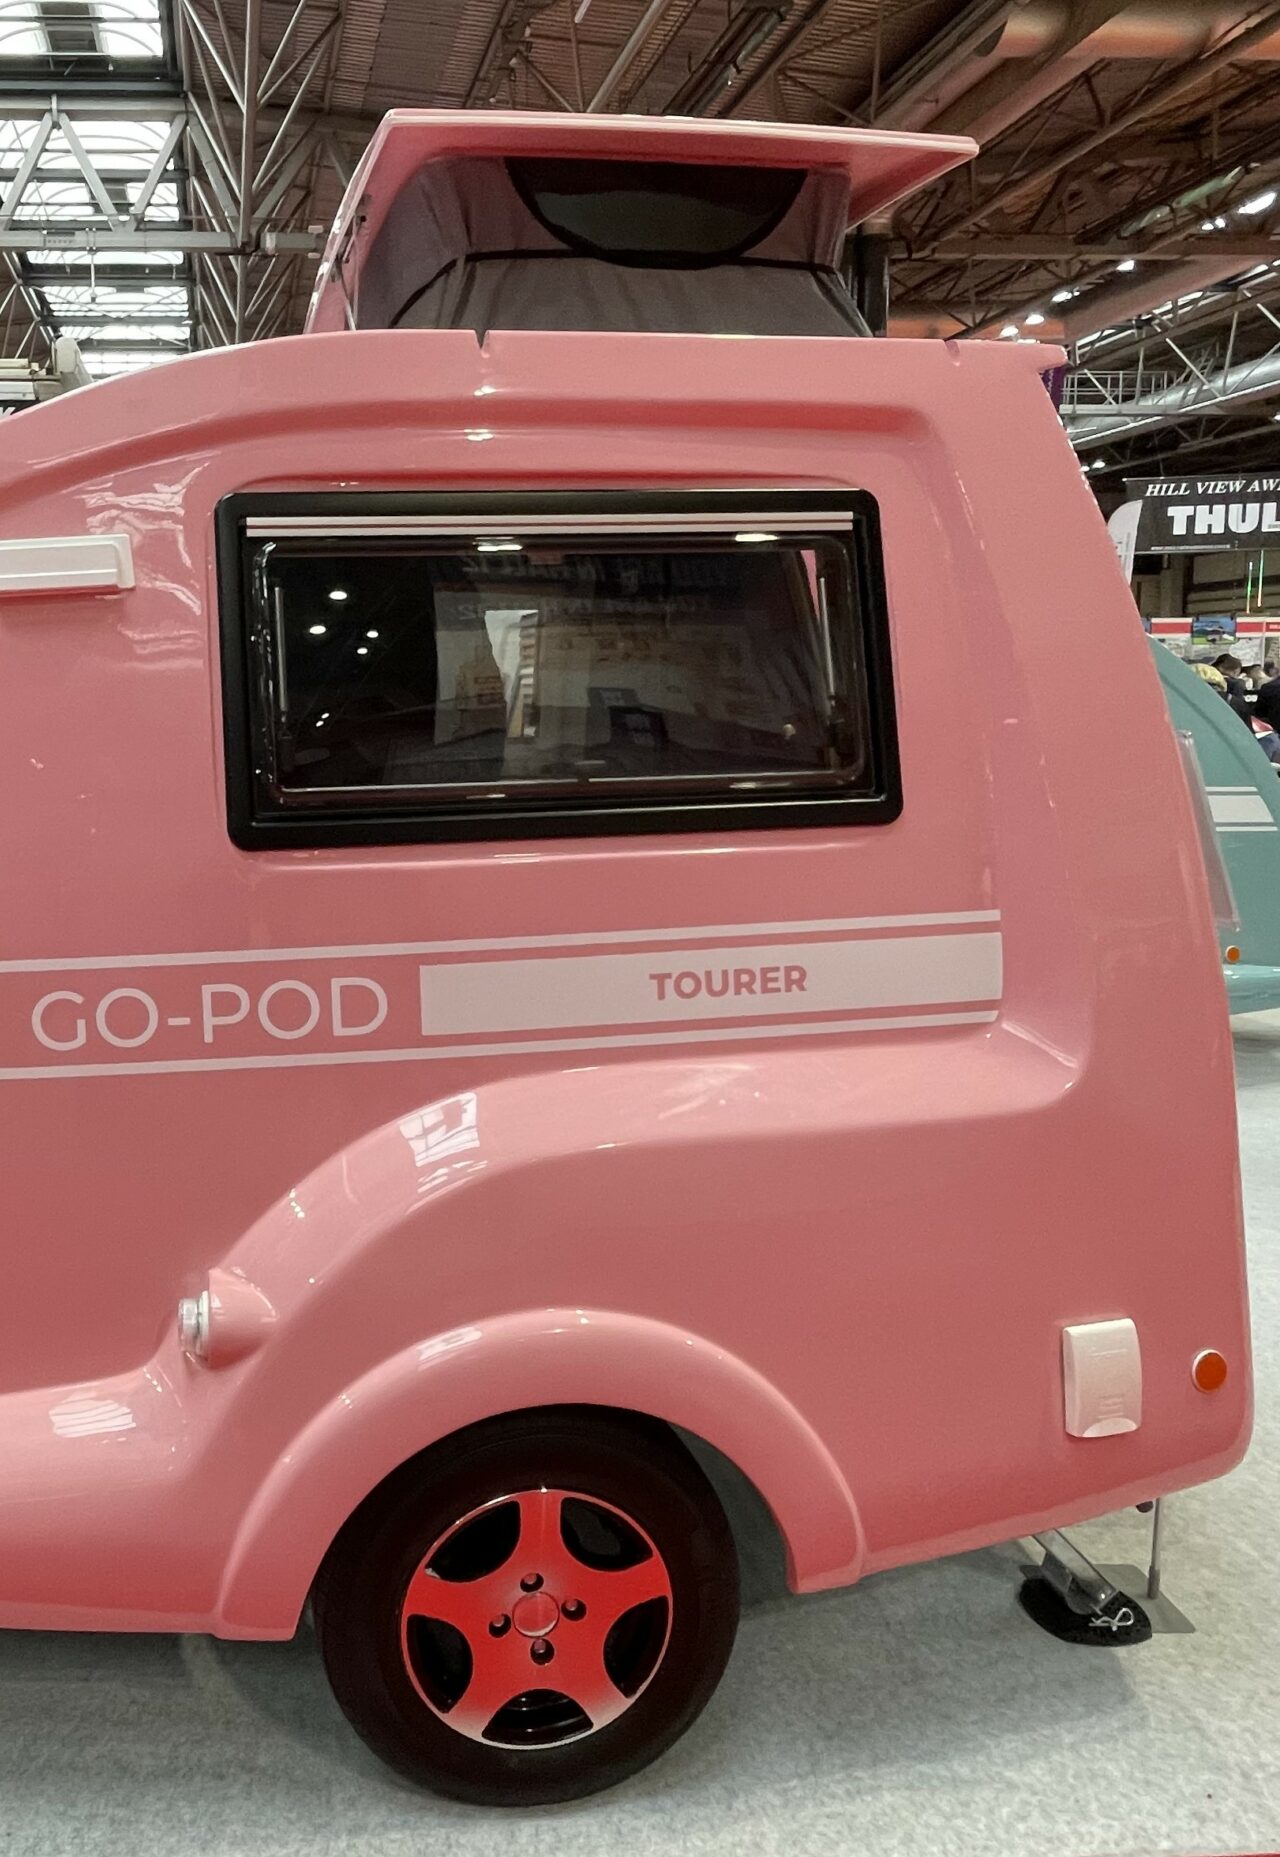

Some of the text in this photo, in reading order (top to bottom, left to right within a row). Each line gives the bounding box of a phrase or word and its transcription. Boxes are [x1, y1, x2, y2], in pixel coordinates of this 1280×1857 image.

[1145, 478, 1280, 497] HILL VIEW AW
[31, 977, 388, 1051] GO-POD
[648, 965, 808, 1001] TOURER
